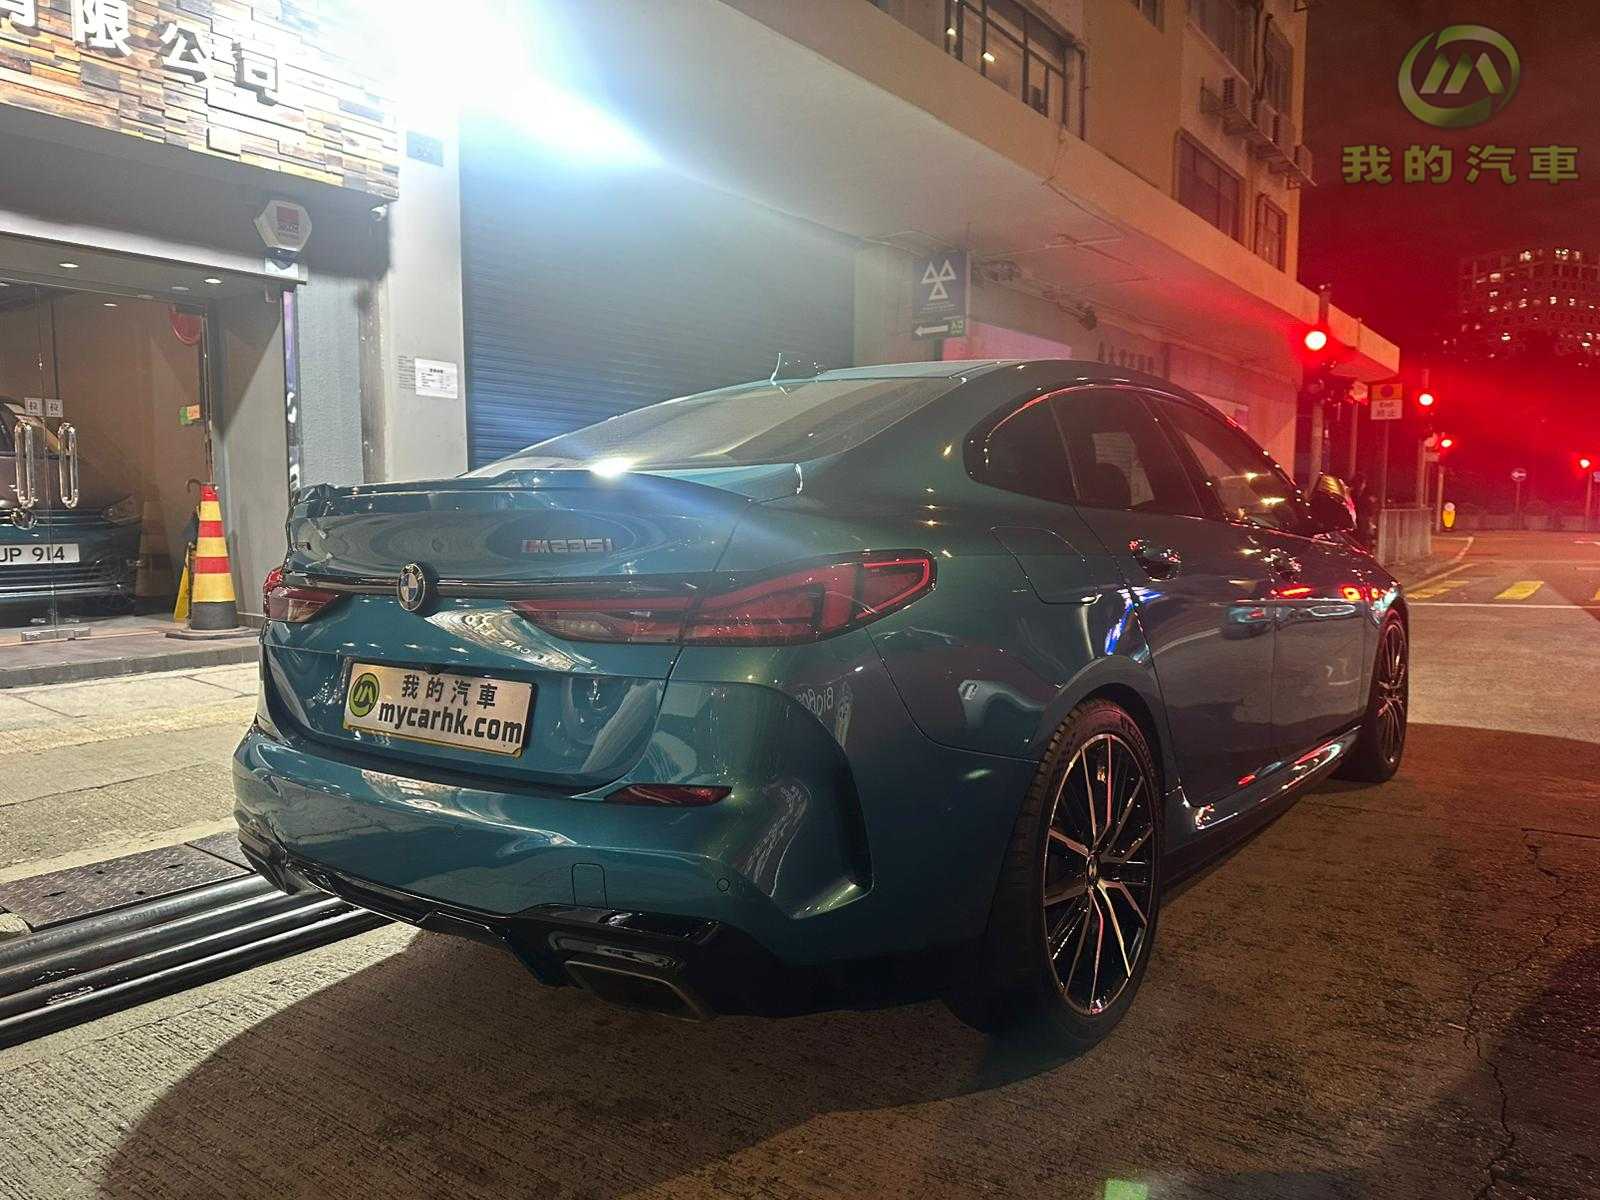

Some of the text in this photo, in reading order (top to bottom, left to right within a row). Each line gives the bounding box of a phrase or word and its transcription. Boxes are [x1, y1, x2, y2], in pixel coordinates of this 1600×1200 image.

[32, 546, 65, 562] 914
[401, 674, 498, 709] 我的汽車
[378, 701, 523, 744] mycarhk.com
